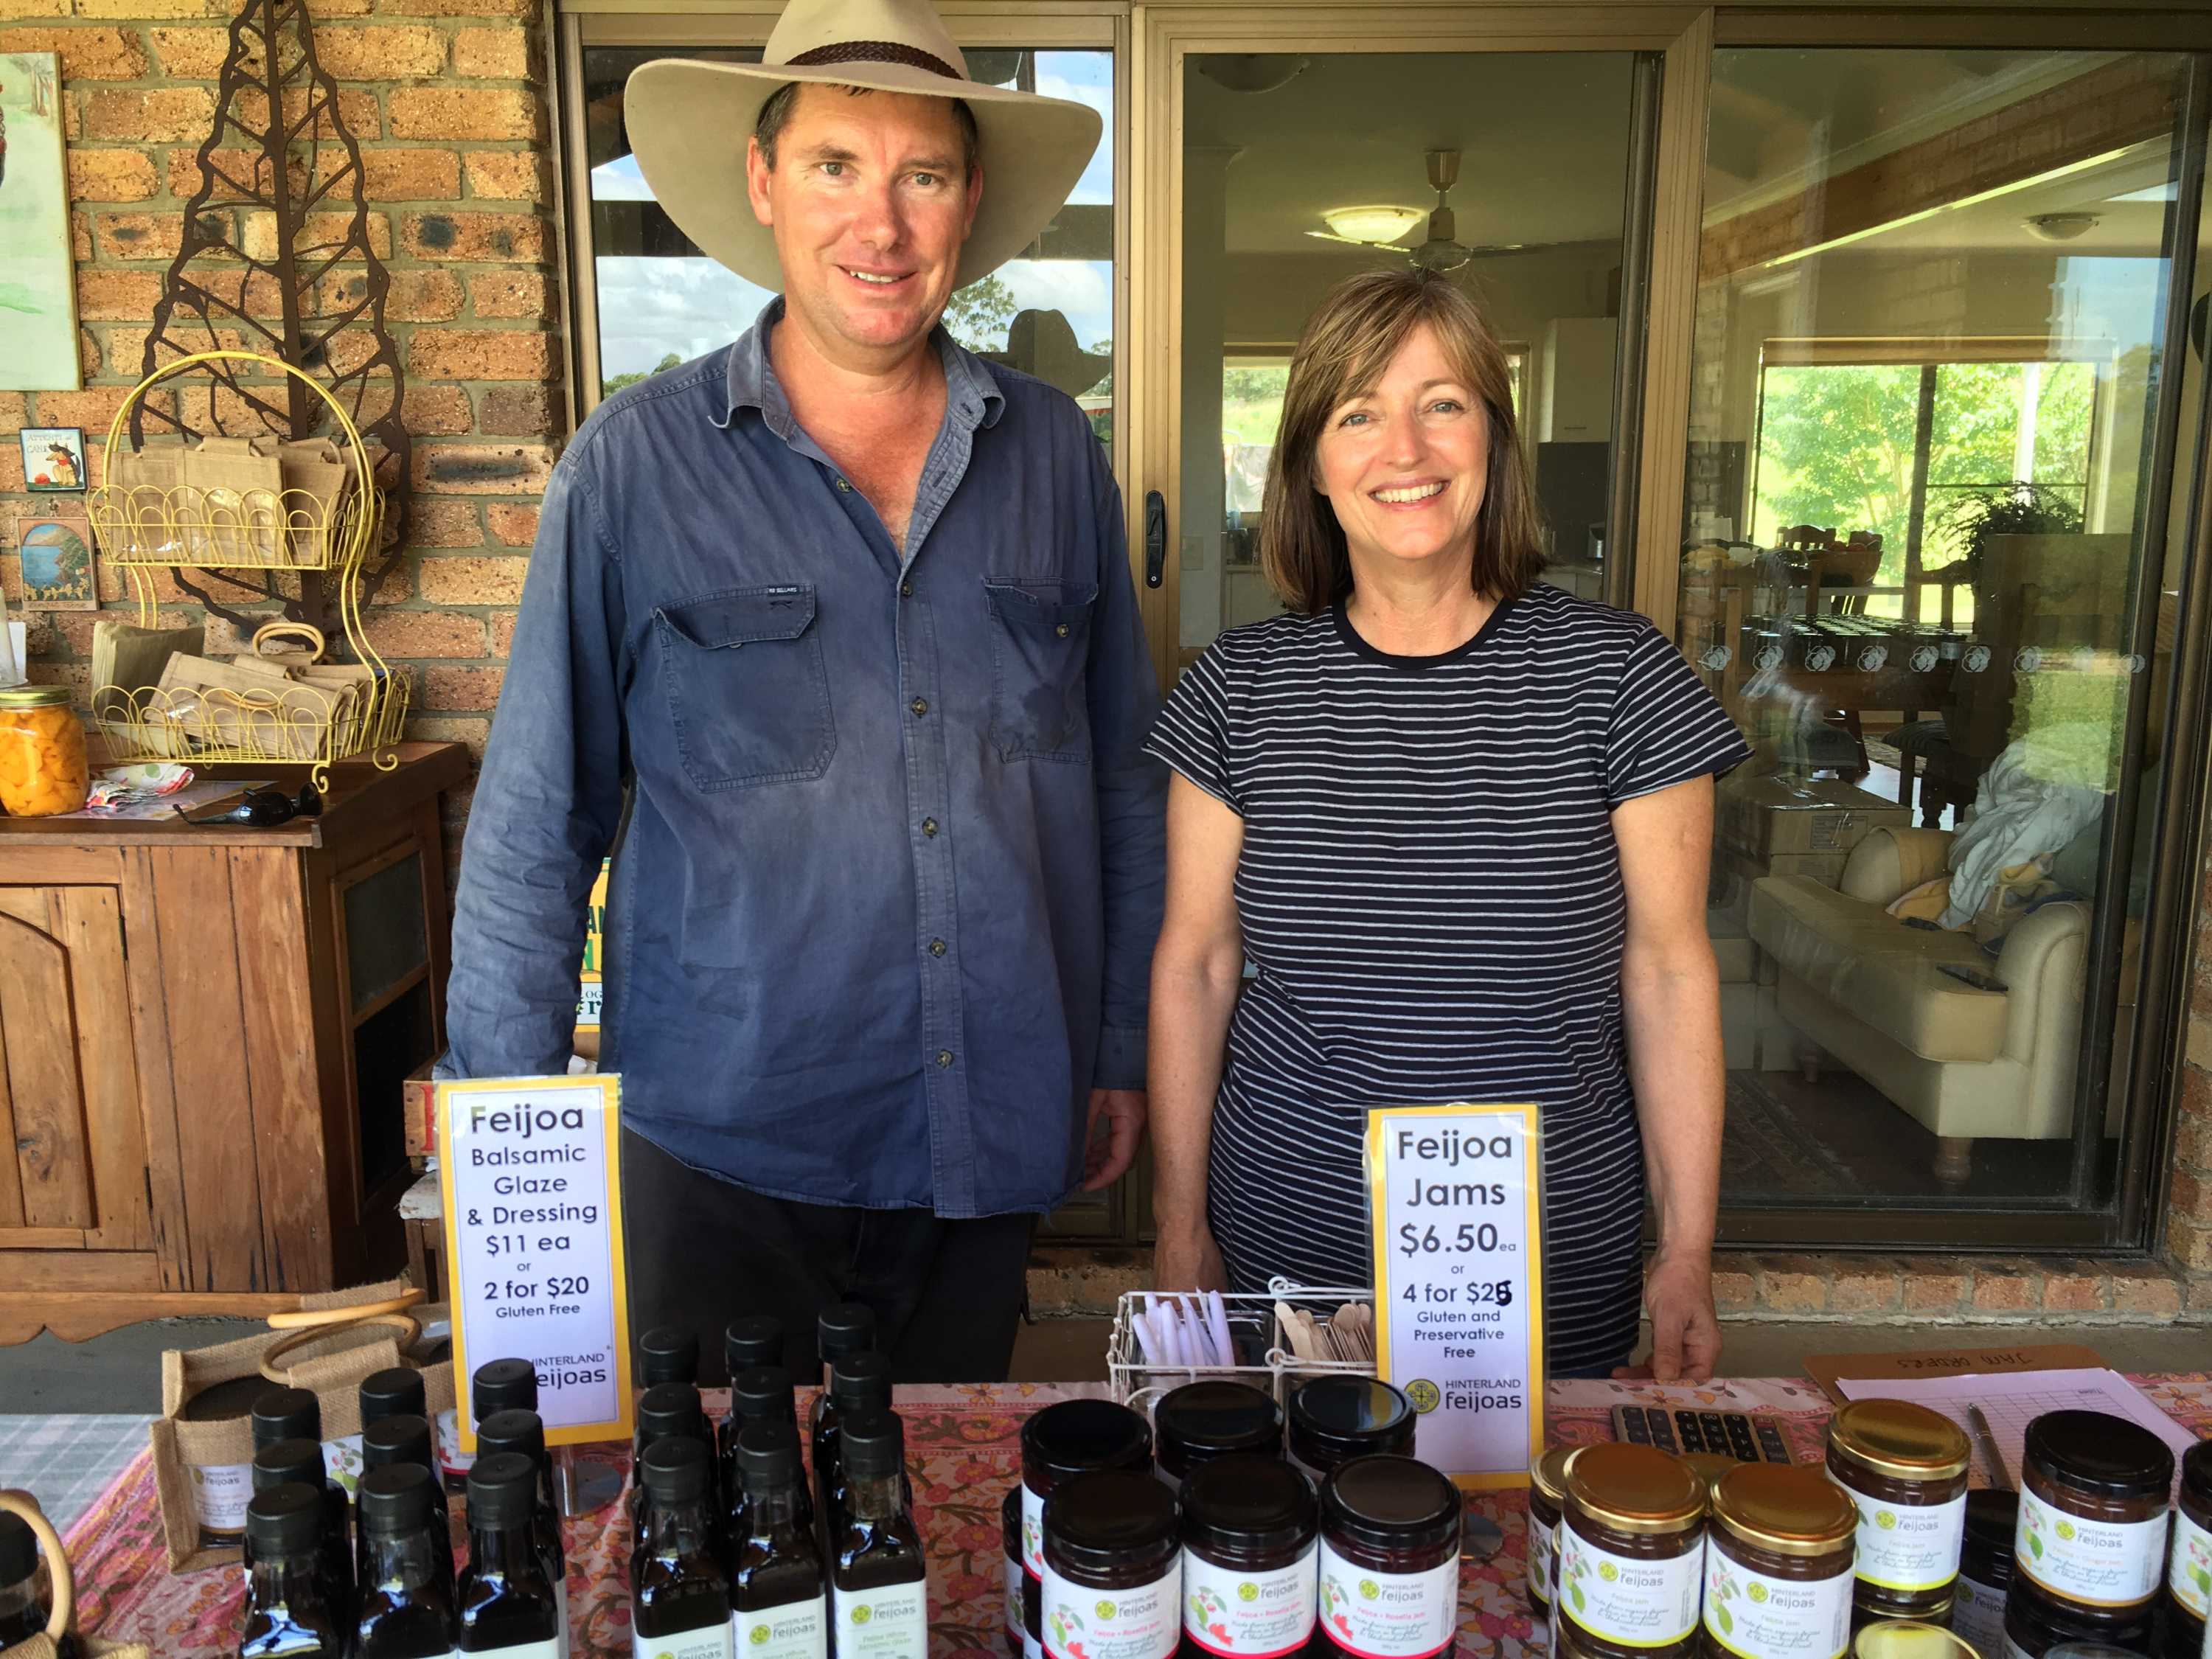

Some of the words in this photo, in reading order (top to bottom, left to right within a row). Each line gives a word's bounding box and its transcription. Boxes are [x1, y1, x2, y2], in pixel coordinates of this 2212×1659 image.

[470, 1103, 583, 1138] Feijoa
[472, 1144, 586, 1166] Balsamic
[1399, 1129, 1512, 1166] Feijoa
[494, 1176, 568, 1194] Glaze
[1406, 1178, 1506, 1207] Jams
[467, 1208, 482, 1226] &
[493, 1203, 597, 1224] Dressing
[486, 1235, 526, 1256] $11
[538, 1235, 571, 1251] ea
[1399, 1222, 1498, 1258] $6.50
[517, 1262, 532, 1273] or
[1451, 1263, 1464, 1275] or
[484, 1282, 498, 1300] 2
[507, 1279, 538, 1298] for
[546, 1276, 589, 1299] $20
[1402, 1284, 1417, 1303] 4
[1425, 1282, 1458, 1303] for
[495, 1304, 545, 1318] Gluten
[549, 1302, 580, 1315] Free
[1417, 1310, 1467, 1324] Gluten
[1471, 1310, 1500, 1323] and
[1414, 1327, 1505, 1343] Preservative
[1444, 1346, 1476, 1359] Free
[536, 1366, 606, 1390] eijoas
[1445, 1378, 1521, 1389] HINTERLAND
[1445, 1391, 1522, 1413] feijoas
[1898, 1520, 1938, 1533] feijoas
[2077, 1534, 2123, 1548] feijoas
[1621, 1573, 1663, 1588] feijoas
[1261, 1581, 1298, 1599] feijoas
[1382, 1590, 1424, 1603] feijoas
[1119, 1600, 1158, 1618] feijoas
[1770, 1594, 1815, 1609] feijoas
[874, 1606, 917, 1620] feijoas
[773, 1623, 815, 1641] feijoas
